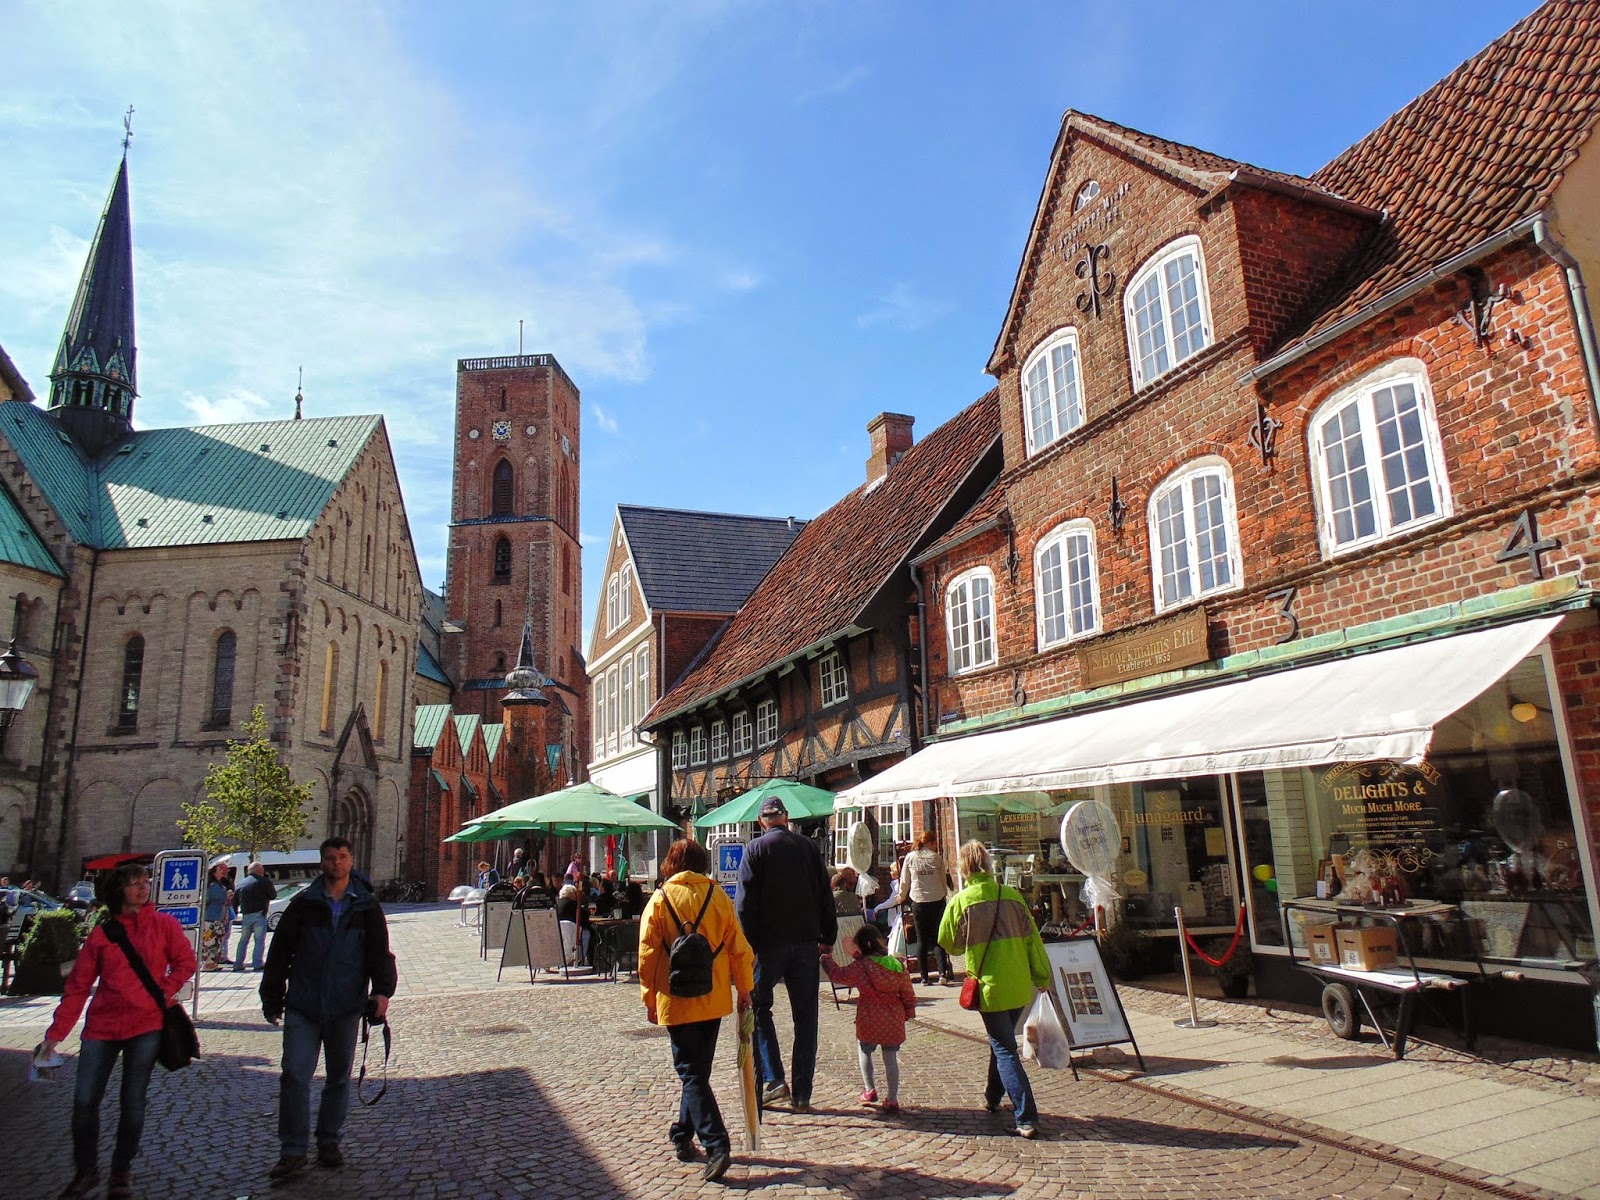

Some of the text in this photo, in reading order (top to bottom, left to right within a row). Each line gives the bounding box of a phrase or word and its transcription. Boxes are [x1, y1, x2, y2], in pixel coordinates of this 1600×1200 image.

[1264, 587, 1299, 645] 3
[1496, 509, 1561, 579] 4
[1333, 780, 1426, 801] DELIGHTS &
